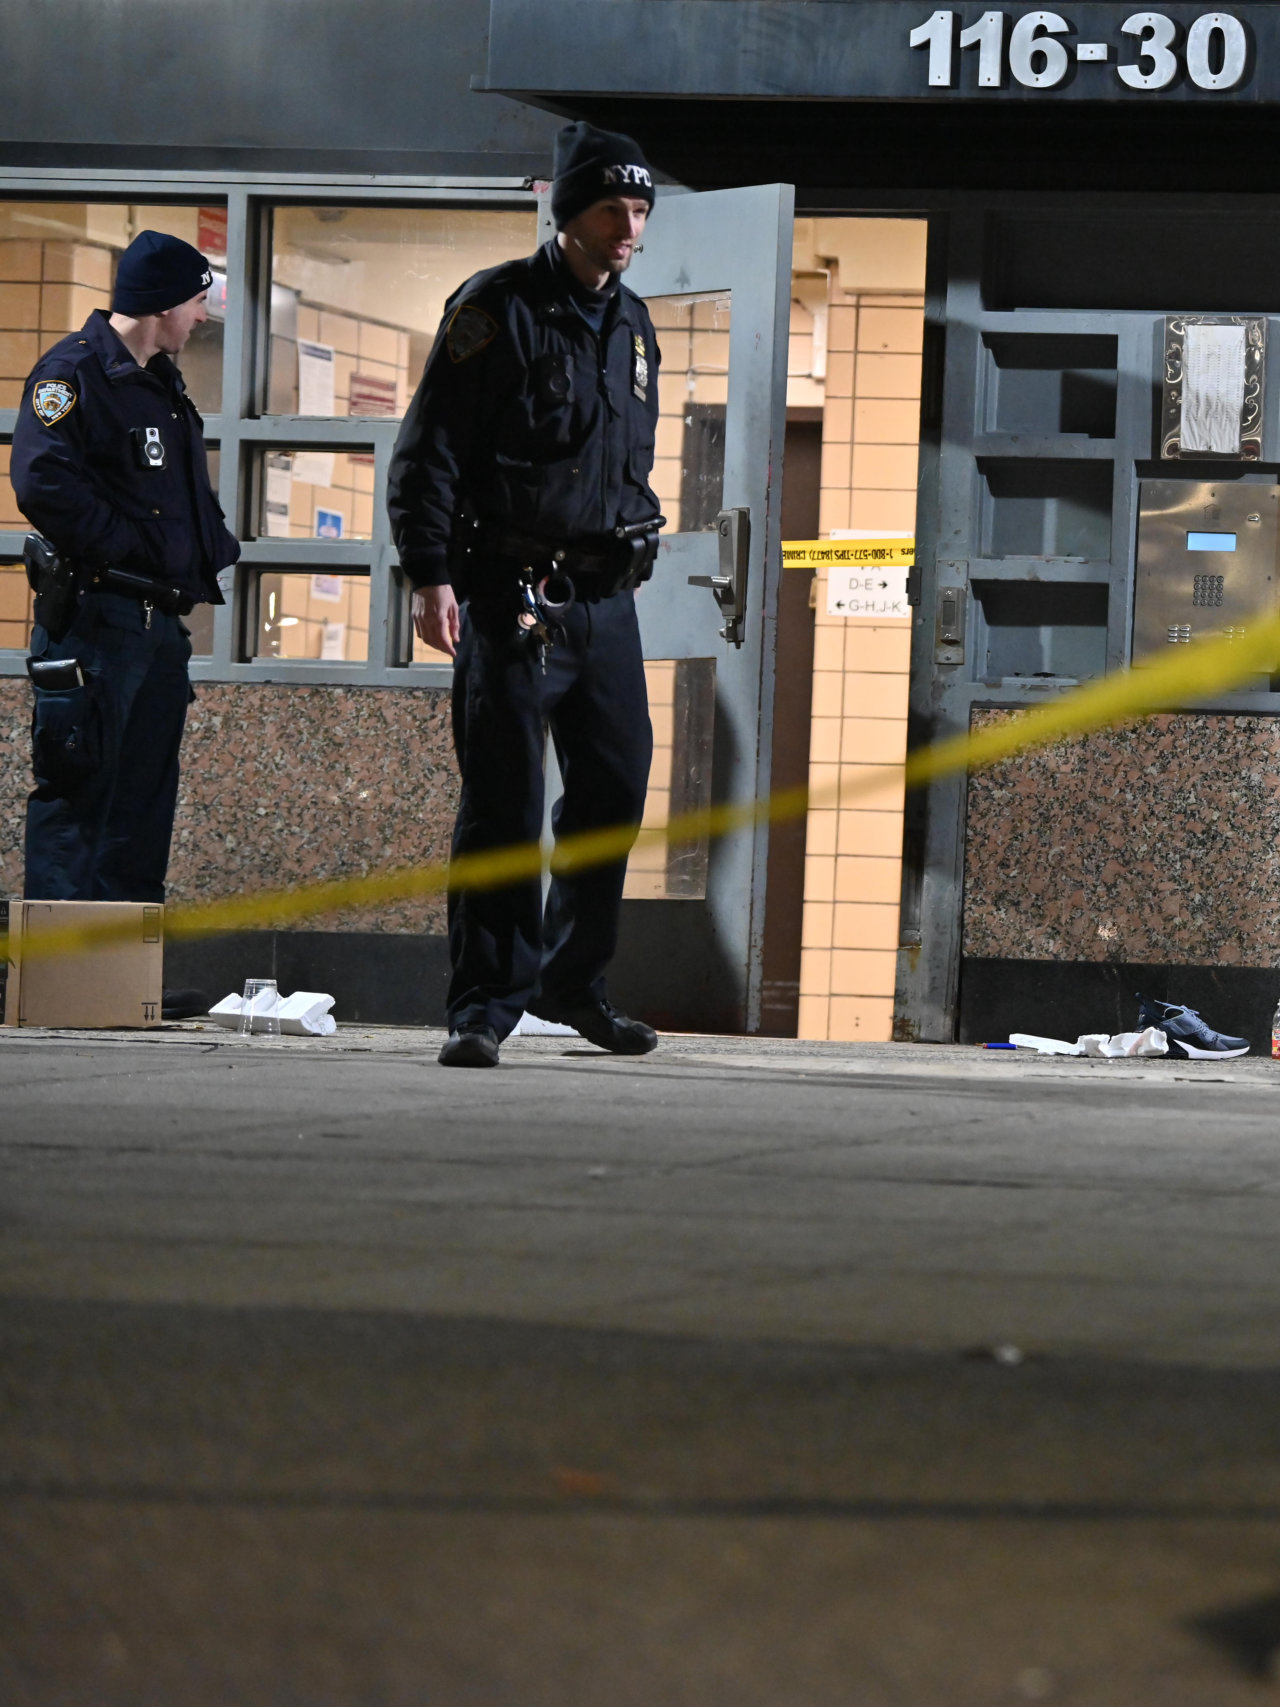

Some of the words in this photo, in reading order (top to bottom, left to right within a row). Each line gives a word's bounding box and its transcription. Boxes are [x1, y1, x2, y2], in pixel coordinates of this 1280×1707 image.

[909, 10, 1247, 91] 116-30
[602, 164, 653, 188] NYPD
[848, 578, 874, 591] D-E
